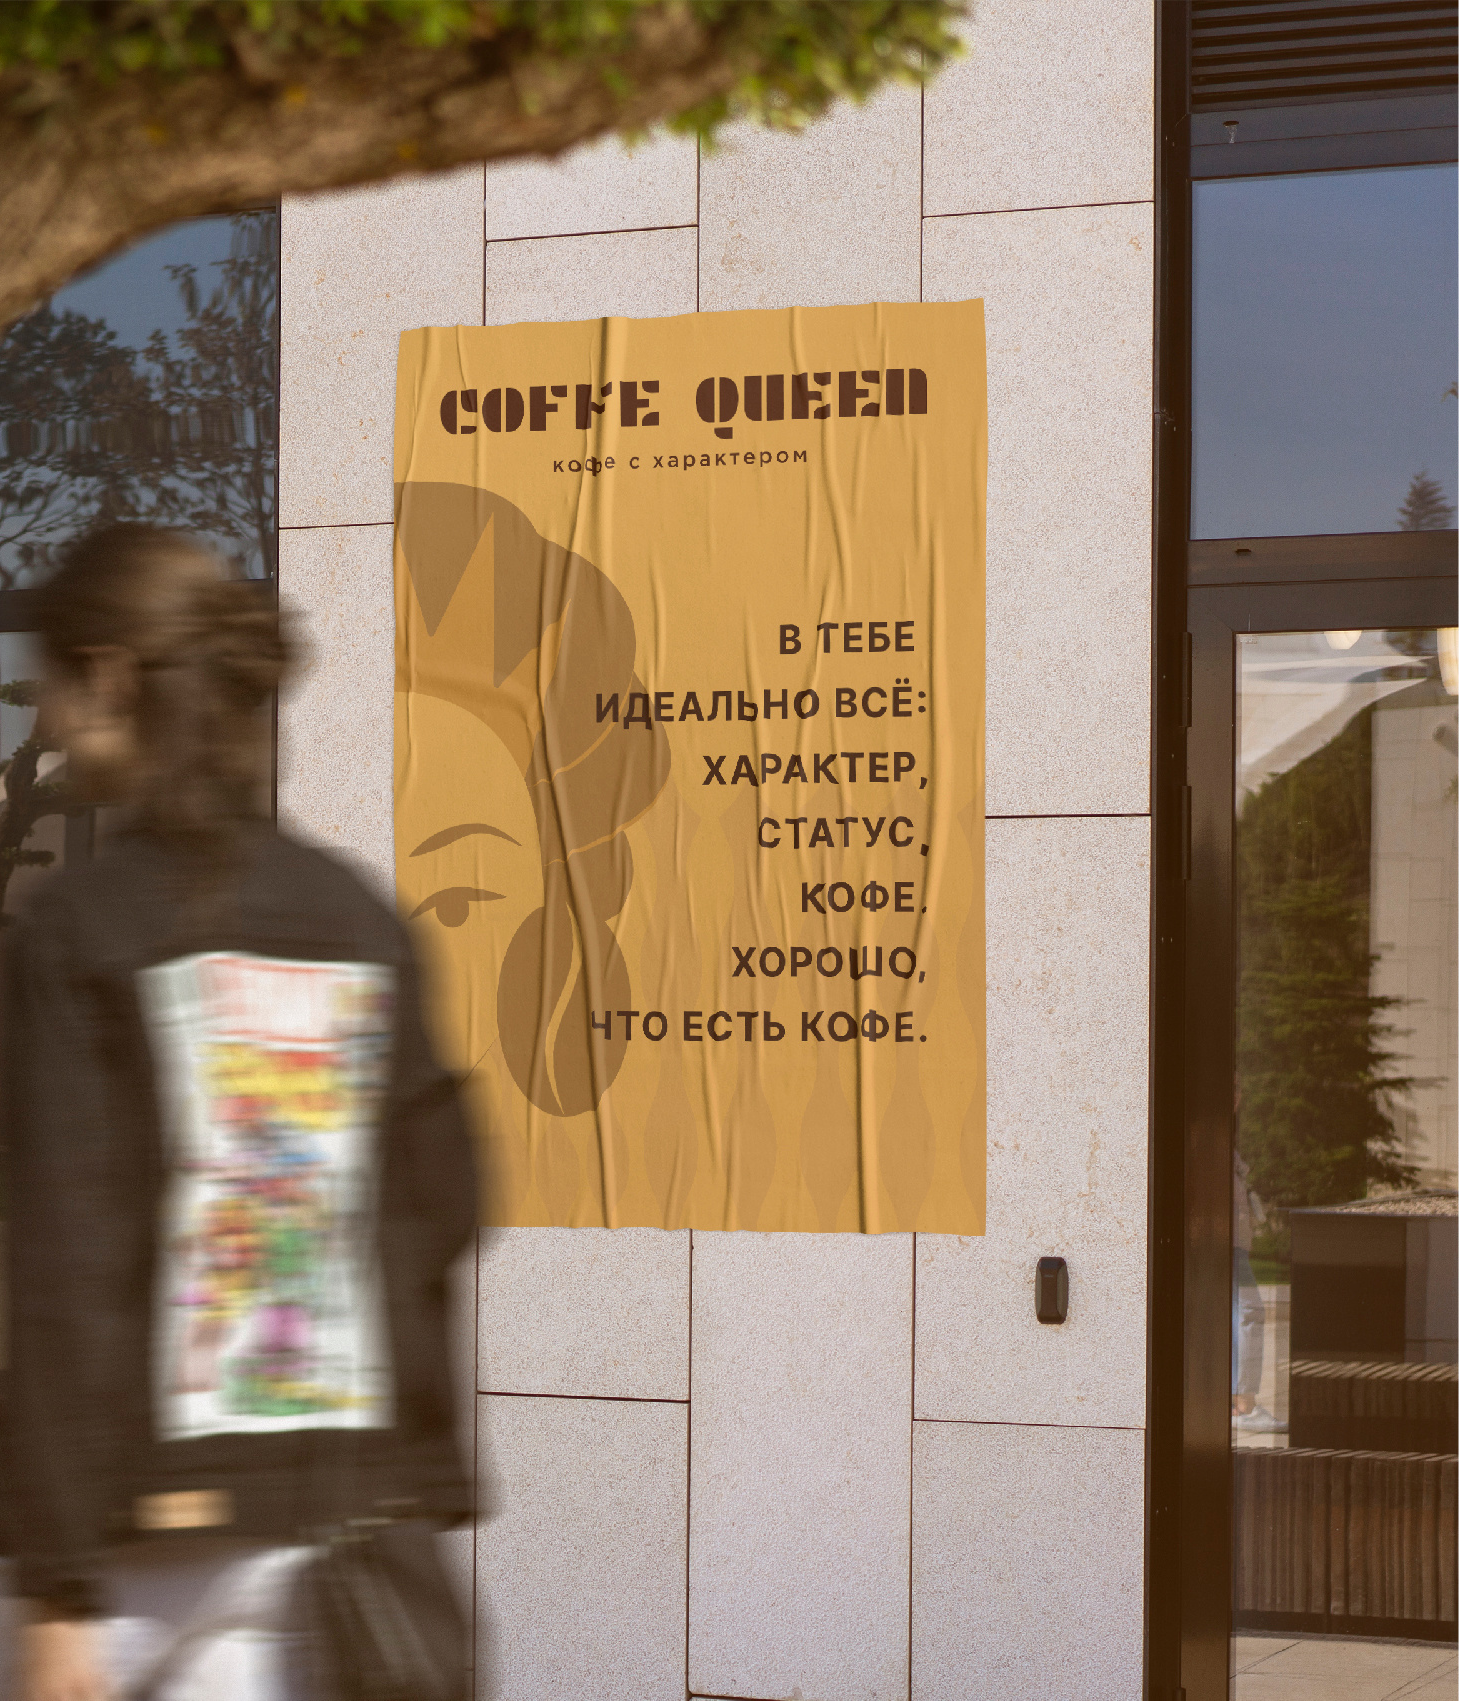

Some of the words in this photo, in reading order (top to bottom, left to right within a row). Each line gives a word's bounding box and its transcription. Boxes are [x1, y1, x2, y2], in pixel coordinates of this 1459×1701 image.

[440, 380, 660, 435] COFFE
[695, 368, 928, 440] QUEEN
[553, 455, 616, 477] кофе
[628, 456, 641, 470] с
[653, 449, 808, 472] характером
[778, 623, 803, 655] В
[816, 620, 916, 654] ТЕБЕ
[595, 687, 821, 730] ИДЕАЛЬНО
[834, 677, 928, 719] ВСЁ:
[701, 751, 929, 790] ХАРАКТЕР,
[757, 816, 930, 857] СТАТУС,
[730, 945, 927, 984] ХОРОШО,
[591, 1010, 669, 1043] ЧТО
[683, 1010, 787, 1043] ЕСТЬ
[800, 1008, 928, 1044] КОФЕ.
